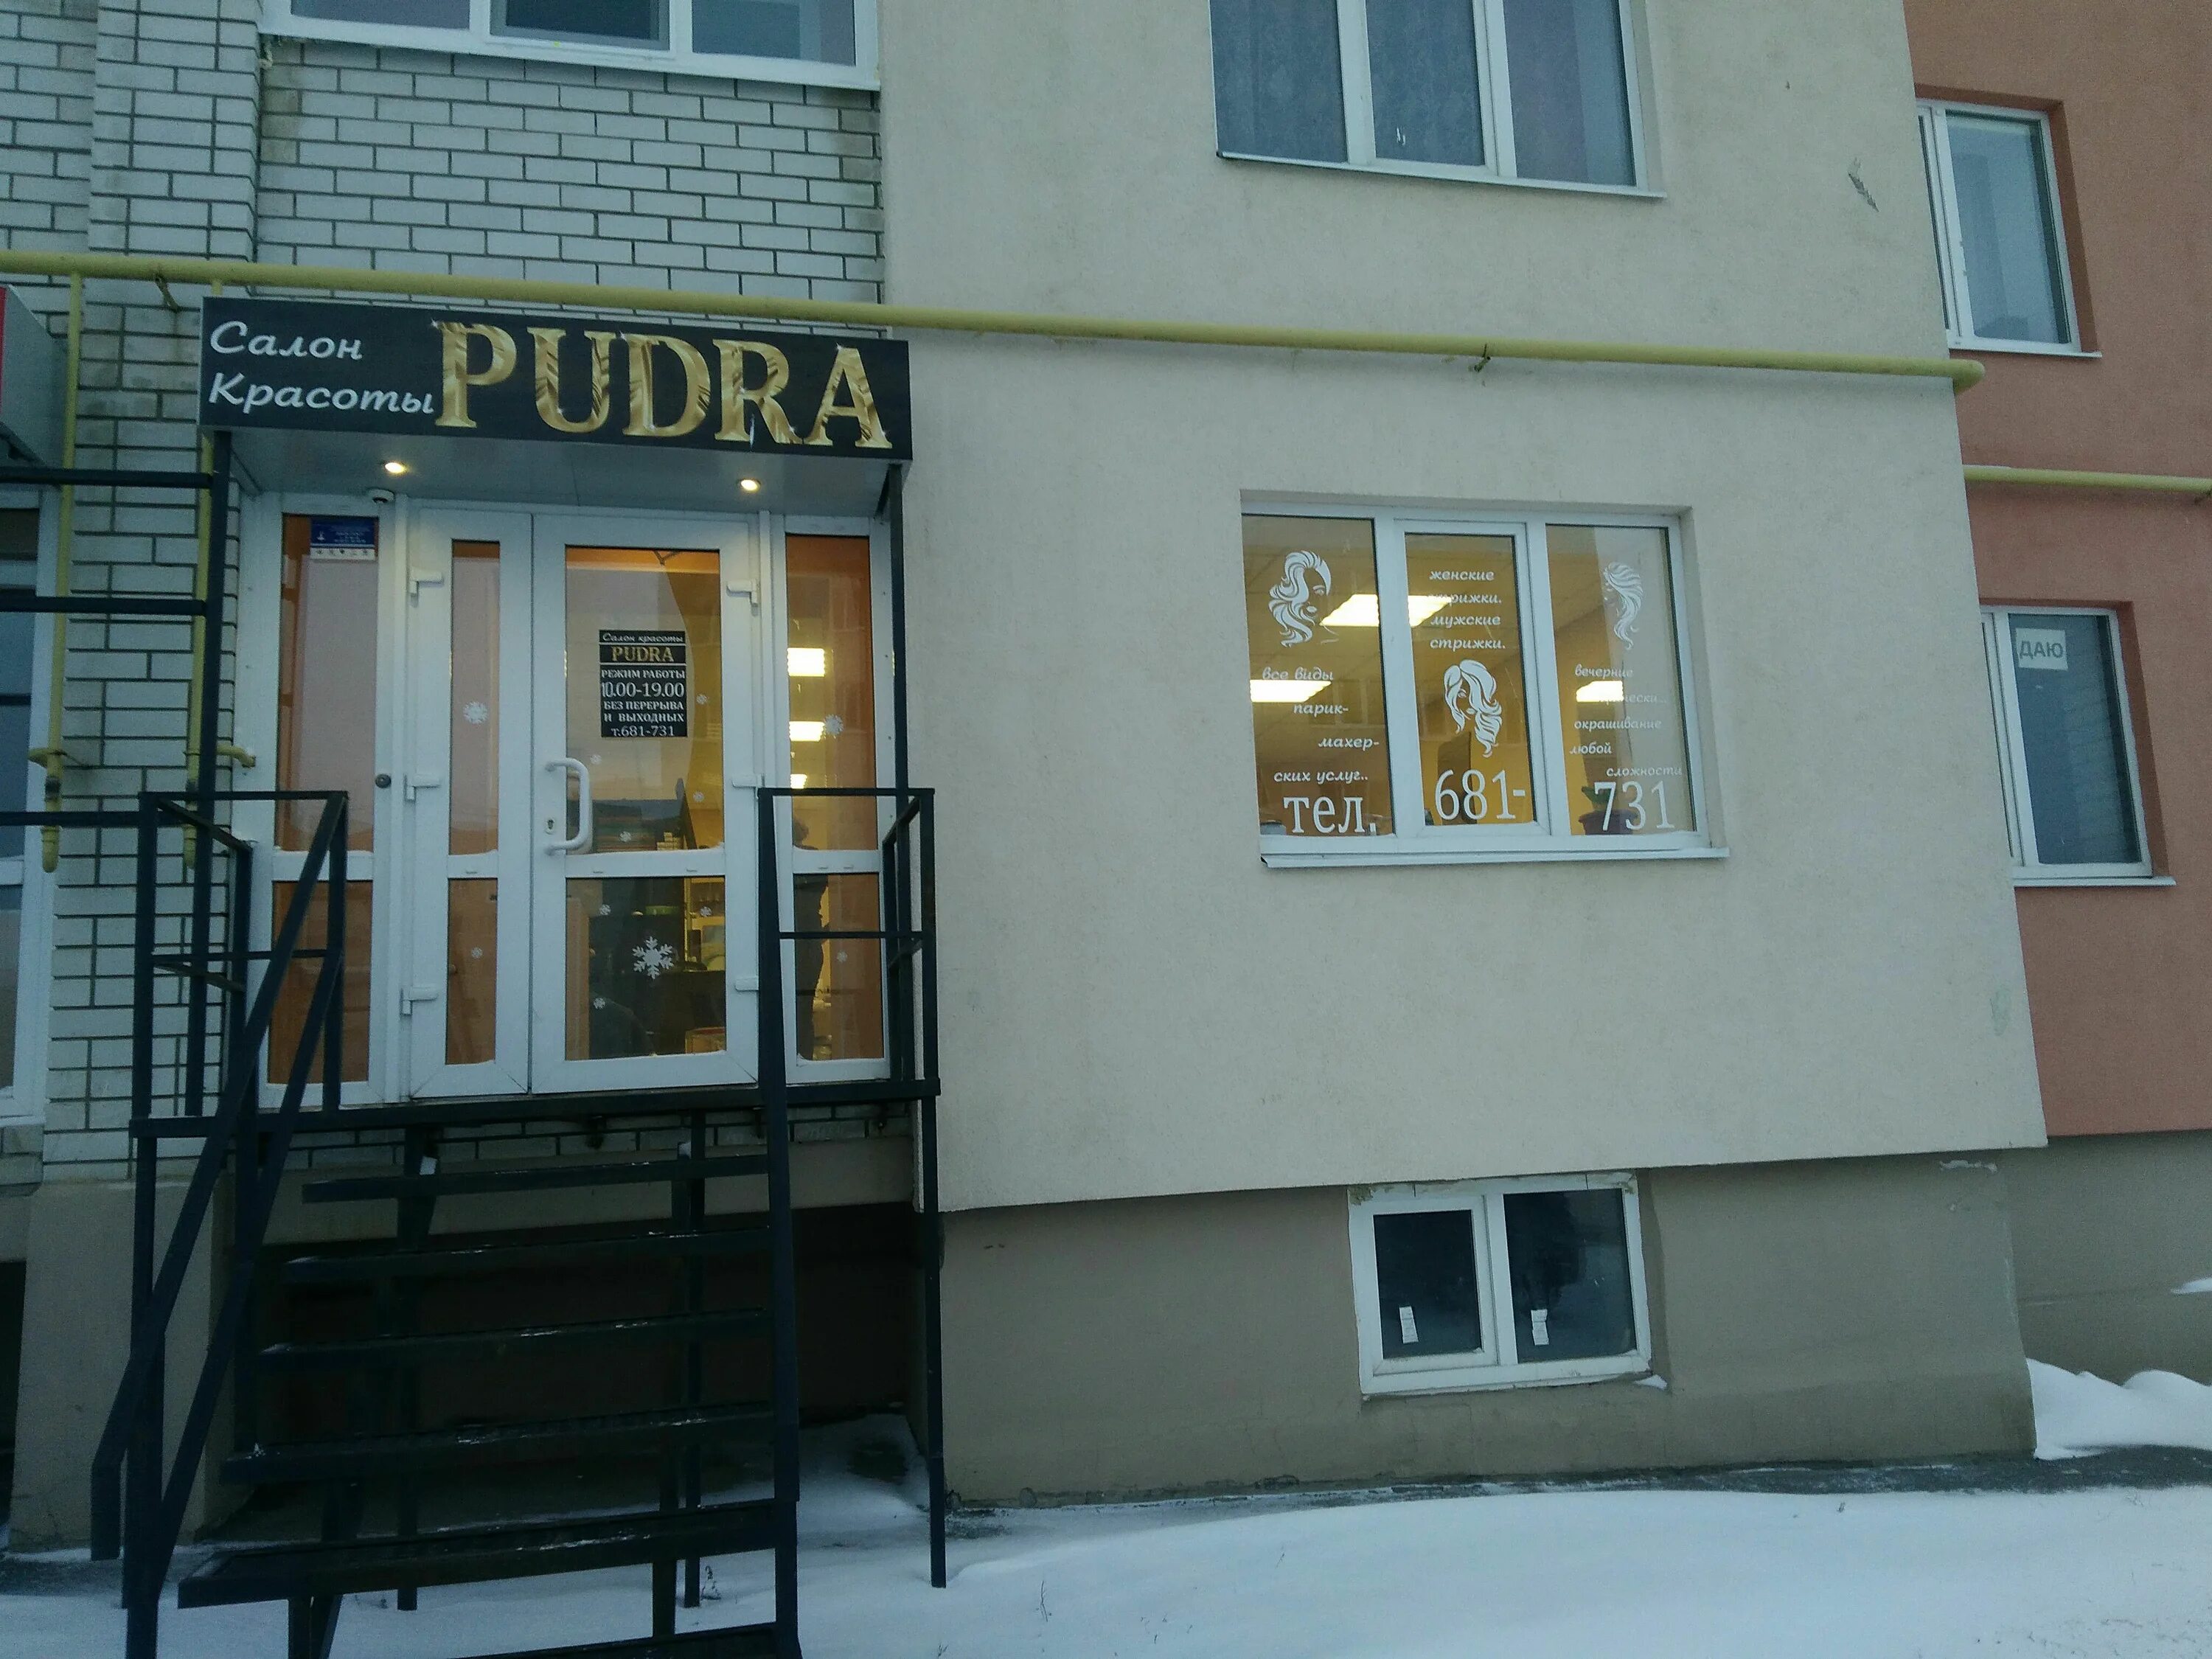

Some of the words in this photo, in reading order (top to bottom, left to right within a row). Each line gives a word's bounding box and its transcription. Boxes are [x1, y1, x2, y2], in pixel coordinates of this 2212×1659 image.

[209, 321, 363, 360] Салон
[434, 320, 892, 449] PUDRA
[208, 372, 434, 414] Красоты
[1429, 571, 1495, 581] женские
[1427, 594, 1502, 607] рижки.
[1430, 616, 1501, 628] мужские
[602, 633, 636, 642] Салон
[1430, 639, 1506, 652] стрижки.
[2020, 641, 2064, 660] ДАЮ
[611, 646, 675, 662] PUDRA
[601, 669, 641, 678] РЕЖИМ
[642, 670, 685, 679] РАБОТЫ
[1262, 667, 1289, 681] все
[1294, 667, 1334, 681] виды
[1575, 664, 1635, 679] вечерние
[601, 681, 685, 698] 10.00-19.00
[604, 701, 624, 710] БЕЗ
[626, 701, 684, 710] ПЕРЕРЫВА
[1293, 703, 1349, 717] парик-
[604, 713, 612, 722] И
[619, 713, 684, 723] ВЫХОДНЫХ
[1574, 715, 1662, 732] окрашивание
[1318, 737, 1380, 751] махер-
[1569, 742, 1613, 755] любой
[1273, 771, 1311, 782] ских
[1606, 766, 1682, 777] сложности
[1283, 795, 1377, 834] тел.
[1435, 769, 1526, 820] 681-
[1593, 780, 1675, 832] 731
